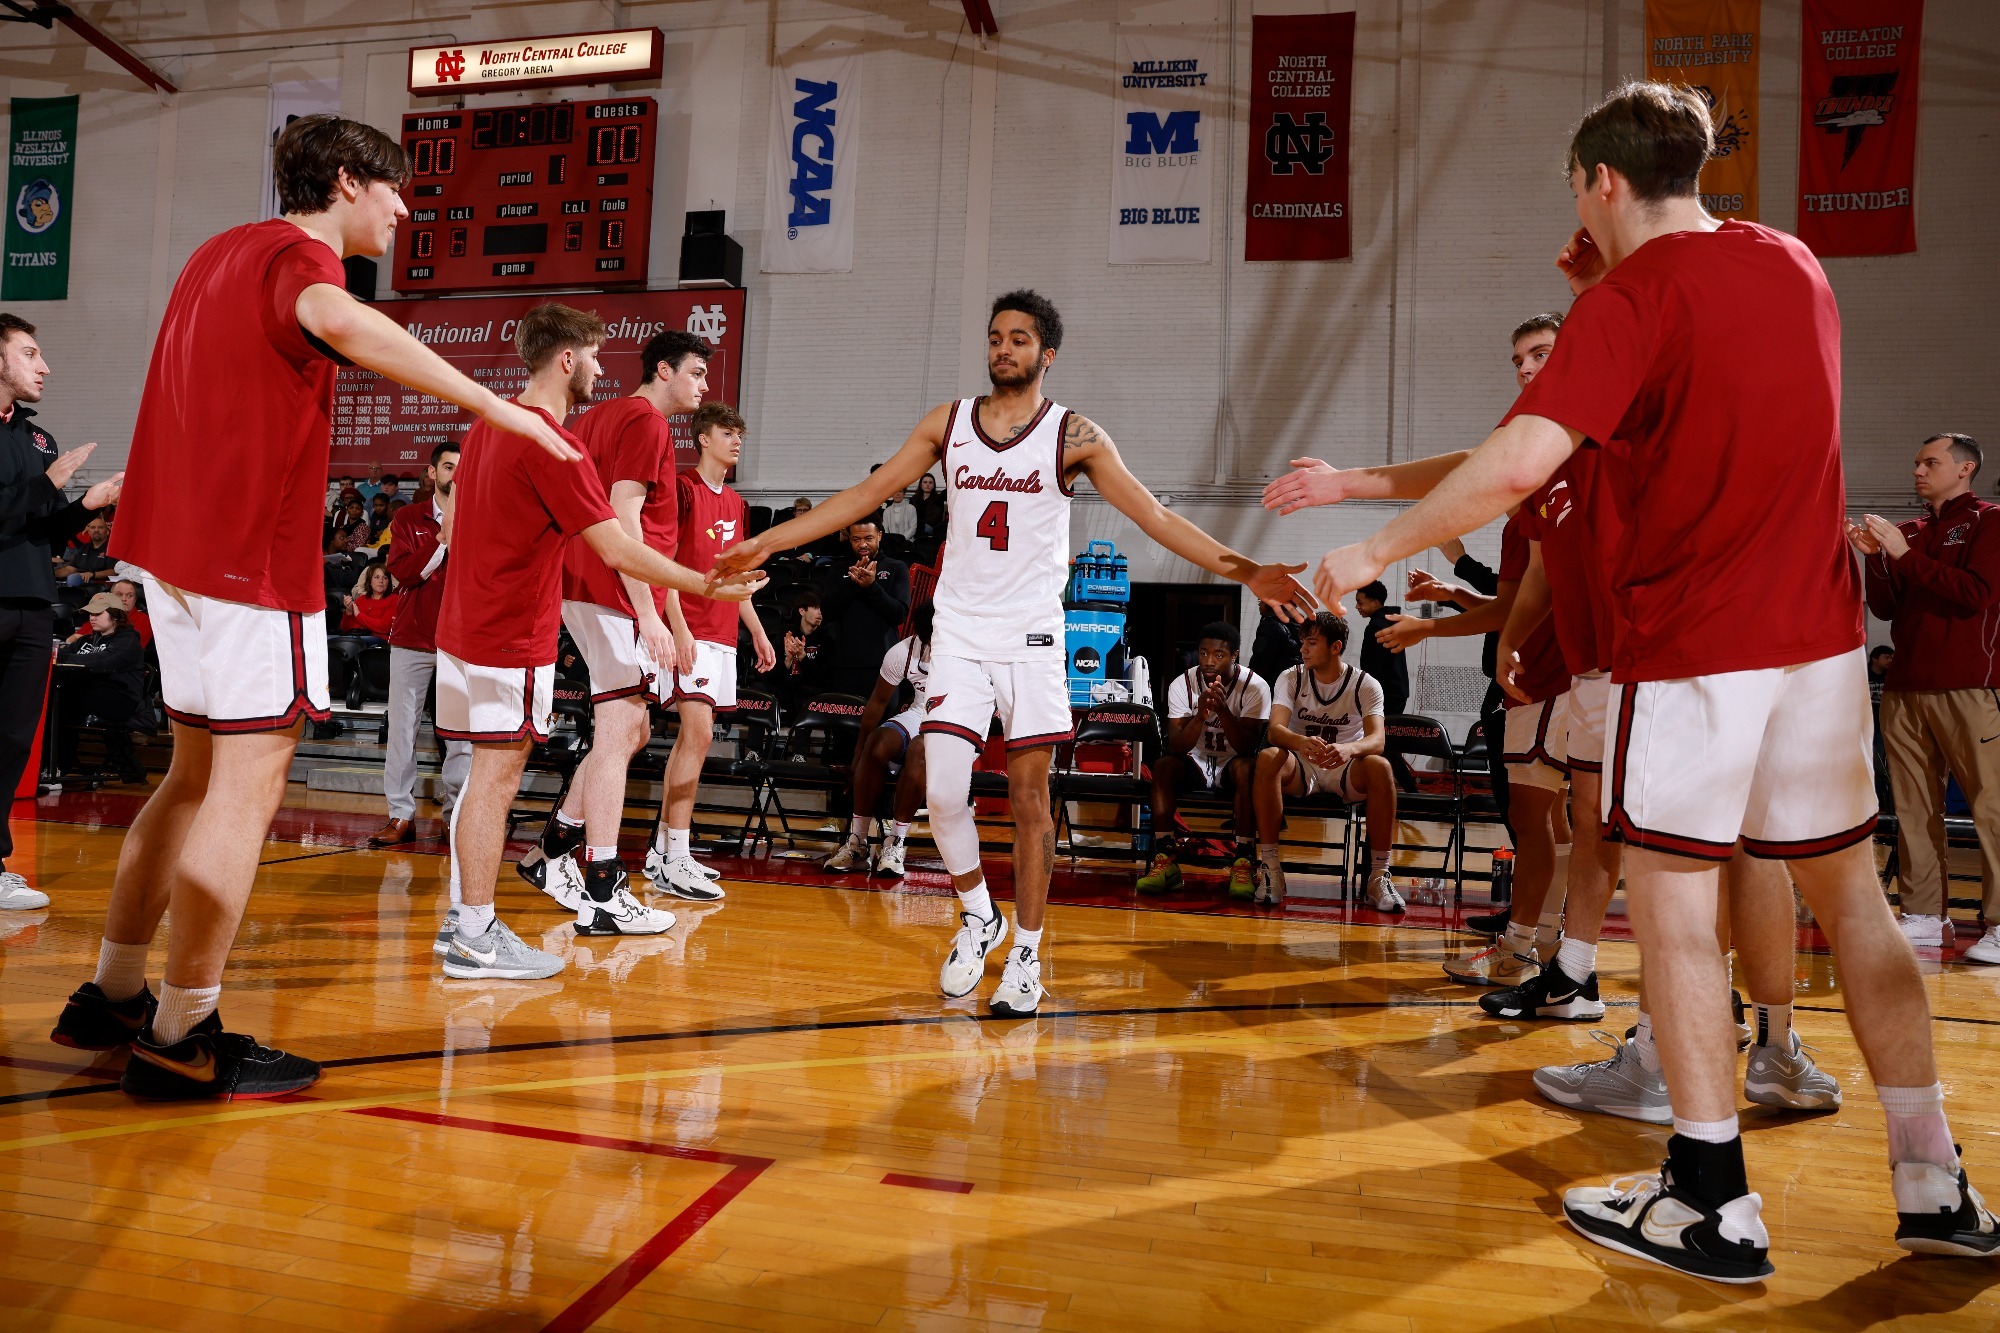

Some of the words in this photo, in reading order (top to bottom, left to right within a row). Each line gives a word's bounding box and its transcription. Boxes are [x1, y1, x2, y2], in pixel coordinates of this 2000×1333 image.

[1821, 26, 1904, 45] WHEATON
[1653, 35, 1705, 51] NORTH
[1711, 34, 1753, 49] PARK
[480, 51, 520, 66] NORTH
[522, 45, 574, 61] CENTRAL
[577, 41, 628, 58] COLLEGE
[1654, 50, 1751, 68] UNIVERSITY
[1825, 44, 1897, 61] COLLEGE
[1132, 59, 1198, 74] MILLIKIN
[1278, 56, 1327, 68] NORTH
[481, 67, 521, 78] GREGORY
[523, 65, 554, 75] ARENA
[1268, 70, 1336, 83] CENTRAL
[1122, 73, 1208, 88] UNIVERSITY
[1271, 85, 1330, 98] COLLEGE
[595, 105, 638, 118] Guests
[1814, 95, 1897, 117] THUNDER
[418, 118, 449, 131] Home
[474, 106, 572, 148] 20:00
[23, 130, 62, 141] ILLINOIS
[1125, 111, 1200, 155] M
[15, 142, 67, 154] WESLEYAN
[597, 126, 640, 164] 00
[414, 138, 455, 175] 00
[788, 77, 838, 228] NCAA
[13, 153, 70, 166] UNIVERSITY
[1125, 156, 1151, 168] BIG
[1157, 155, 1198, 168] BLUE
[500, 173, 532, 186] period
[602, 200, 625, 212] fouls
[1804, 187, 1910, 212] THUNDER
[414, 211, 435, 221] fouls
[501, 205, 533, 217] player
[1119, 208, 1148, 226] BIG
[1152, 207, 1200, 225] BLUE
[1252, 202, 1343, 219] CARDINALS
[10, 252, 57, 266] TITANS
[601, 259, 619, 269] won
[412, 268, 429, 278] won
[501, 263, 526, 275] game
[406, 320, 492, 345] National
[336, 371, 354, 380] EN'S
[358, 371, 384, 380] CROSS
[474, 368, 501, 377] MEN'S
[336, 383, 374, 392] COUNTRY
[507, 381, 514, 389] &
[442, 405, 459, 414] 2019
[392, 423, 427, 432] WOMEN'S
[429, 423, 471, 432] WRESTLING
[400, 450, 418, 460] 2023
[955, 465, 1043, 494] Cardinals
[976, 501, 1009, 552] 4
[1087, 584, 1126, 592] POWERADE
[1065, 623, 1120, 634] OWERADE
[1076, 659, 1100, 668] NCAA
[808, 701, 866, 716] CARDINALS
[1087, 712, 1151, 724] CARDINALS
[1298, 707, 1350, 726] Cardinals
[1384, 726, 1441, 737] ARDINALS
[1205, 732, 1227, 752] 11
